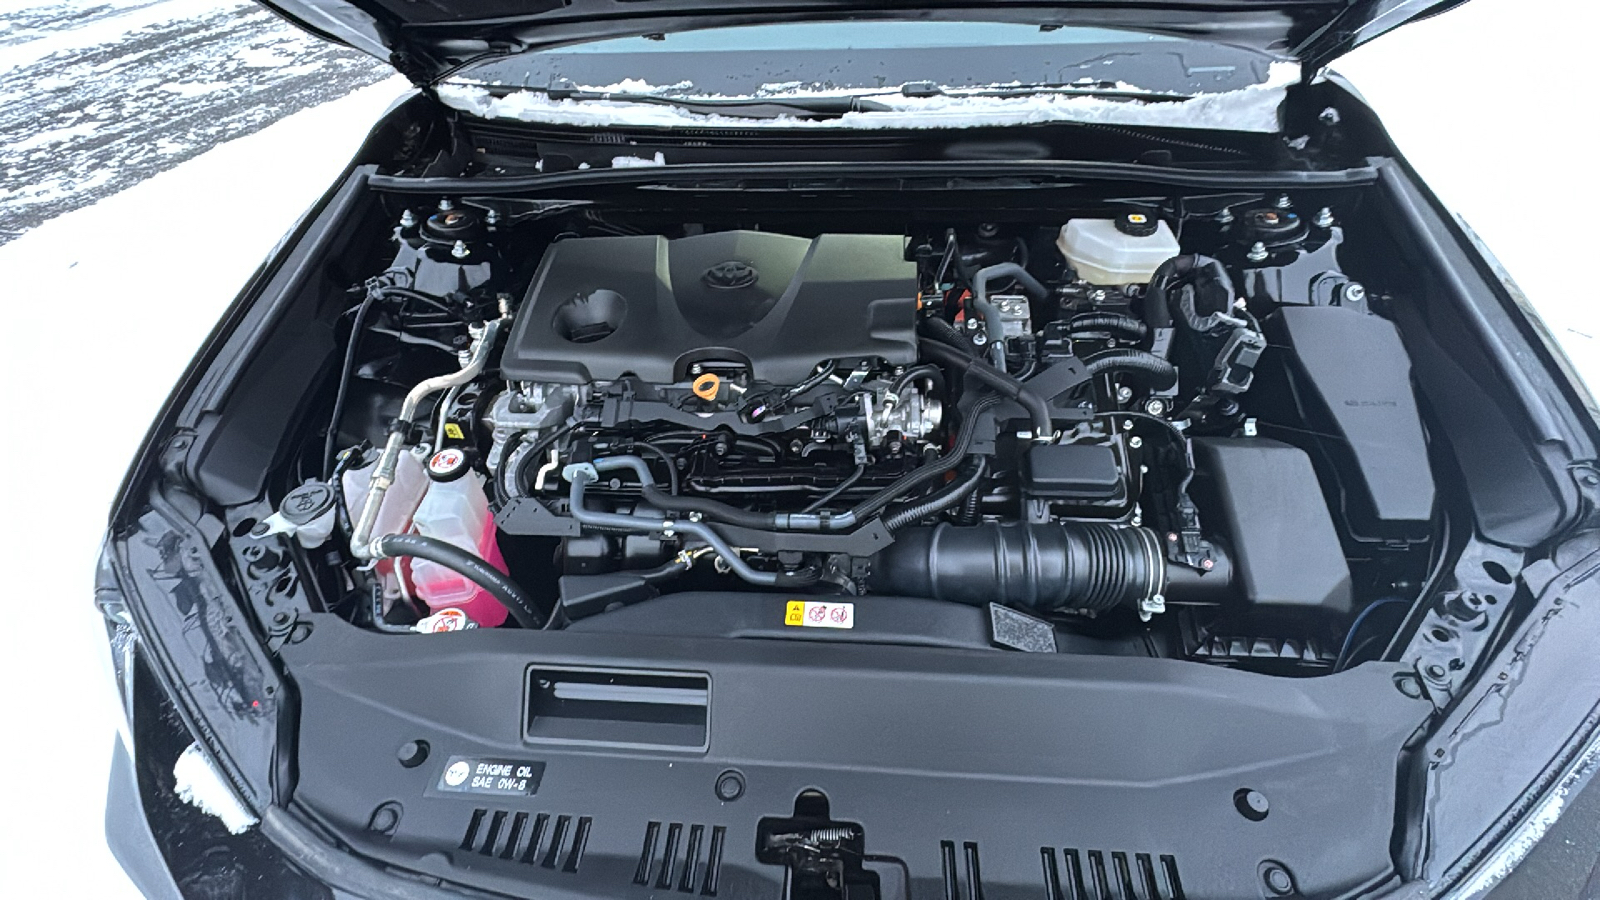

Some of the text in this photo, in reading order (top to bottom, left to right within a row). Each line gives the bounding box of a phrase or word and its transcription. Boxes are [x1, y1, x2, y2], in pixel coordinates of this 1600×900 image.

[475, 762, 533, 778] ENGINE OIL
[471, 776, 527, 791] SAE 0W-8
